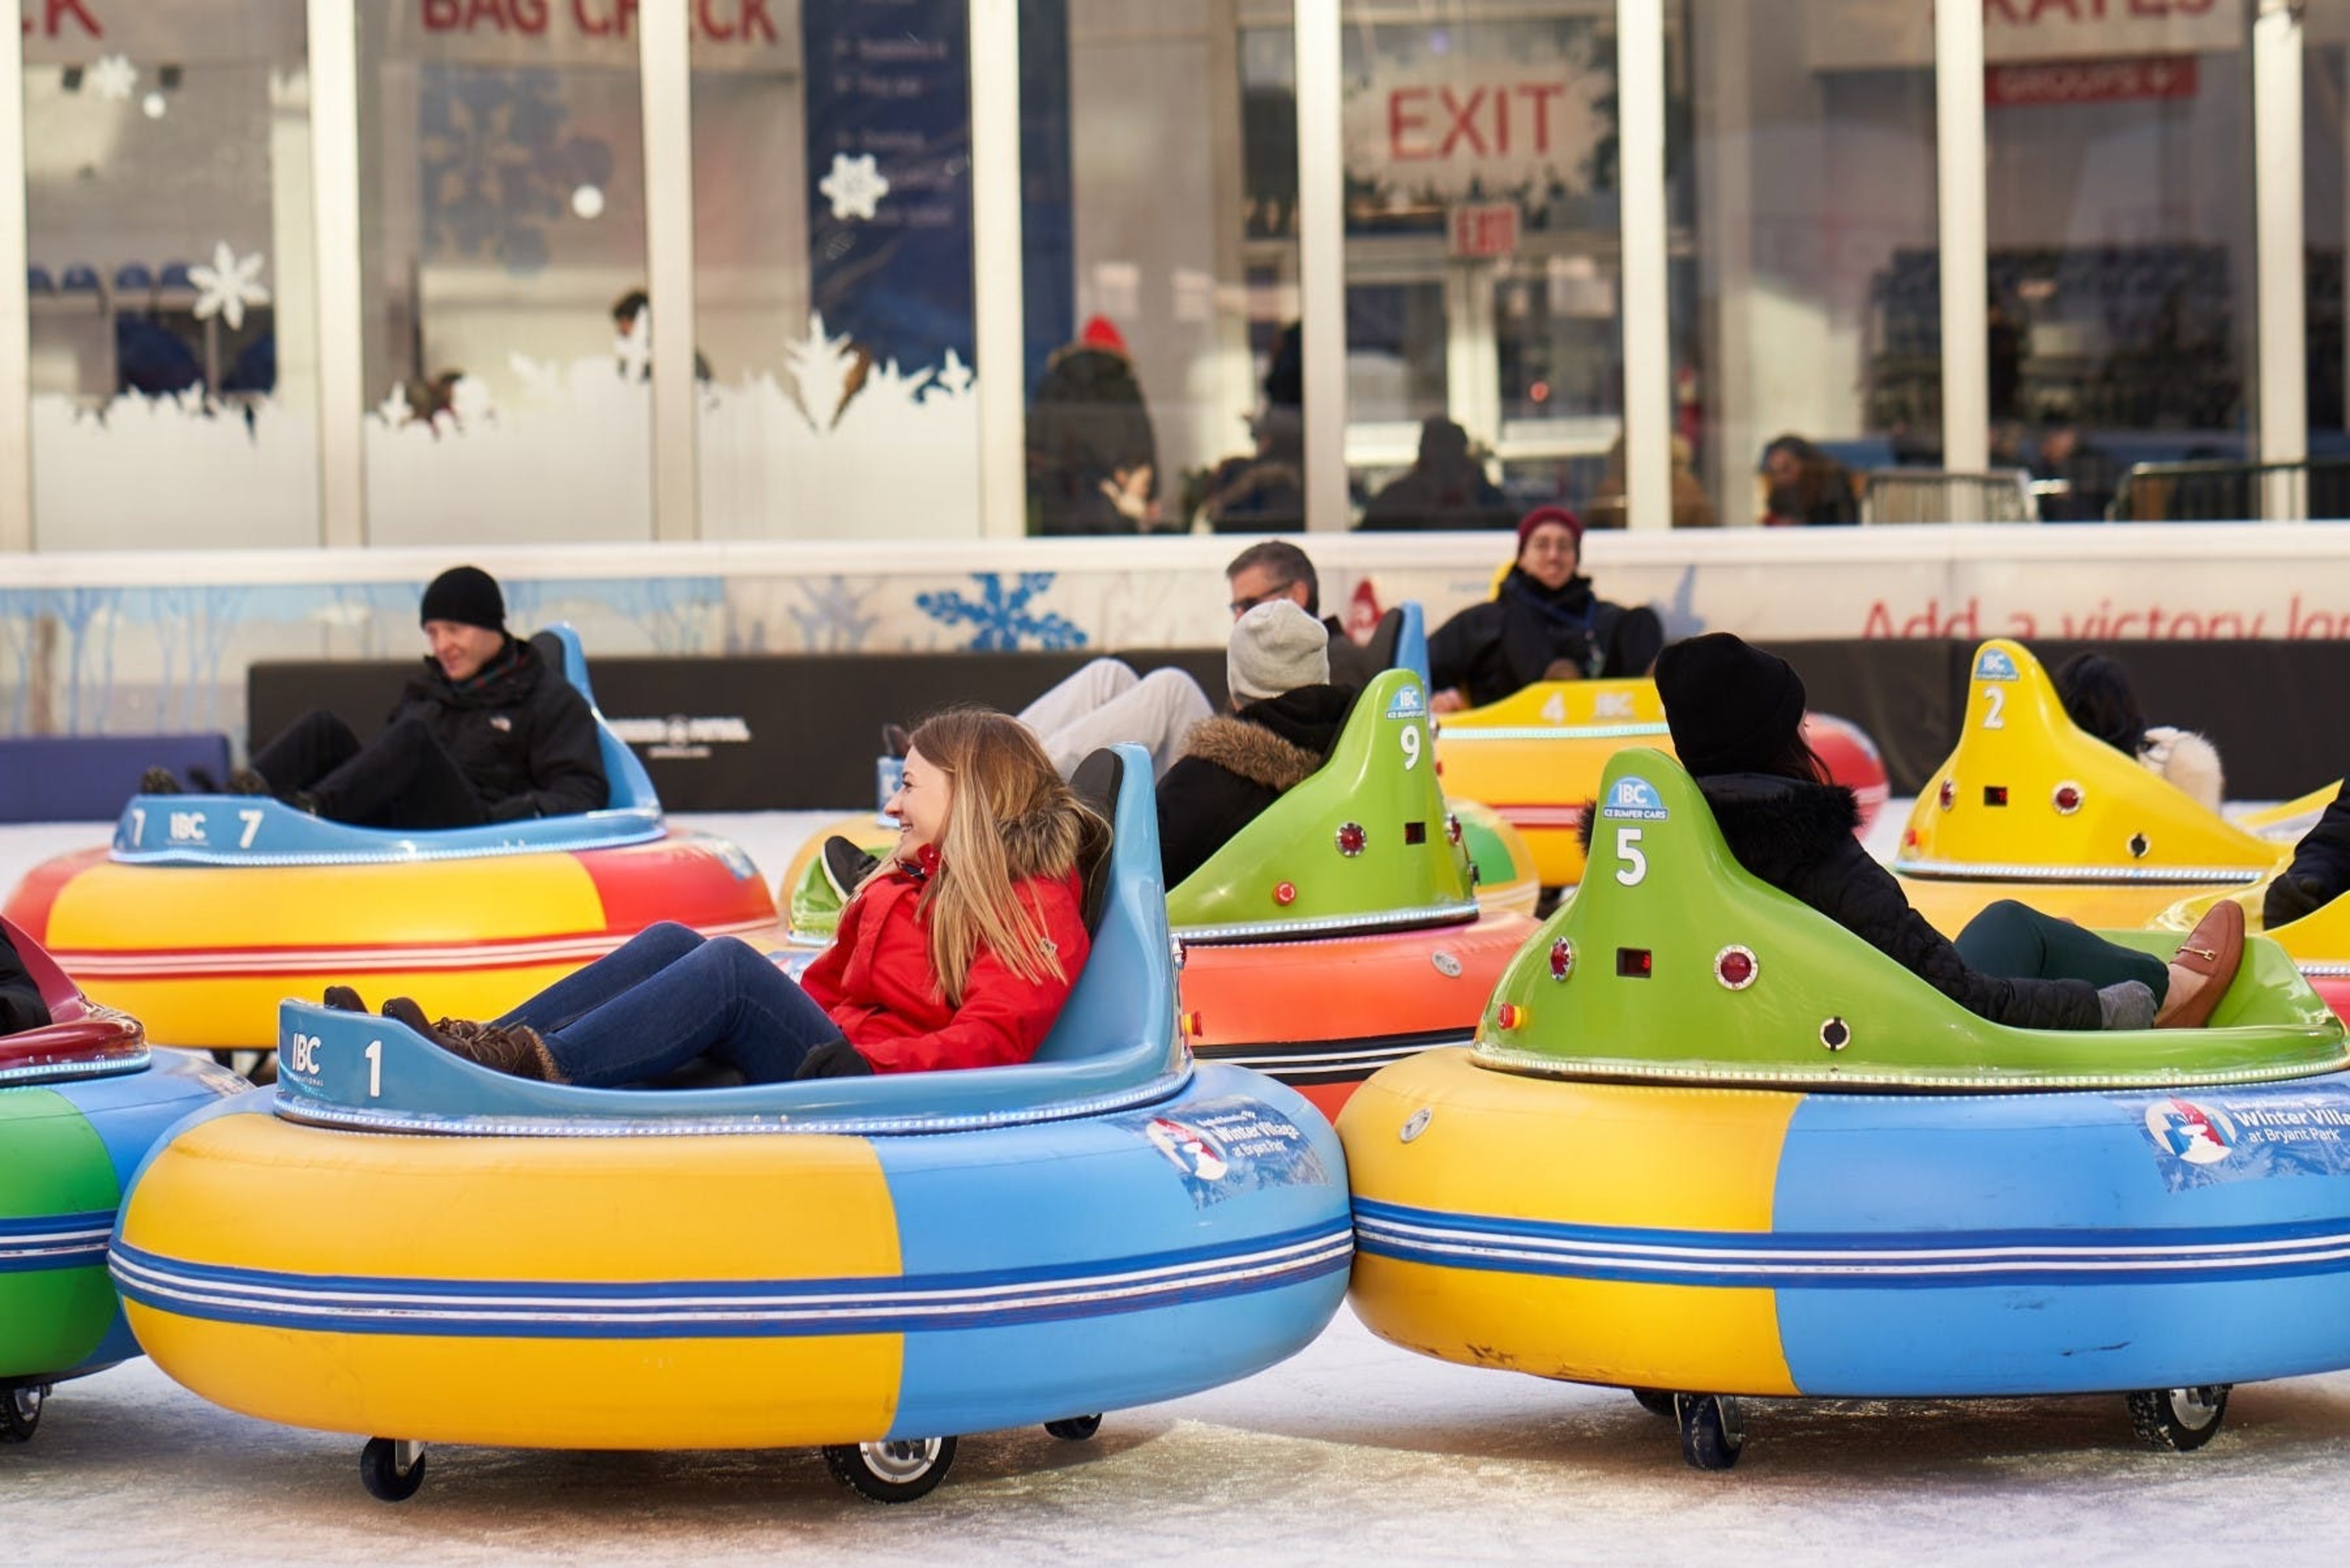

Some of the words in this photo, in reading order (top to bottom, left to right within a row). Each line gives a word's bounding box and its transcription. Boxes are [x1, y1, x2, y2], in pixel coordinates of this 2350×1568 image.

[22, 0, 103, 39] K
[572, 0, 780, 44] CCK
[1388, 81, 1564, 158] EXIT
[1863, 597, 1978, 638] Add
[2008, 613, 2035, 638] a
[1400, 691, 1418, 706] IBC
[1541, 691, 1565, 724] 4
[1983, 687, 2004, 728] 2
[1400, 725, 1420, 771] 9
[1618, 784, 1647, 804] IBC
[170, 811, 206, 840] IBC
[239, 809, 264, 849] 7
[1614, 810, 1643, 818] BUMPER
[1643, 811, 1666, 819] CARS
[1615, 828, 1647, 887] 5
[292, 1032, 321, 1075] IBC
[365, 1039, 382, 1097] 1
[1211, 1125, 1261, 1142] Winter
[1254, 1121, 1300, 1140] Village
[2233, 1110, 2308, 1127] Winter
[2248, 1129, 2265, 1143] at
[2264, 1128, 2310, 1144] Bryant
[2308, 1128, 2341, 1141] Park
